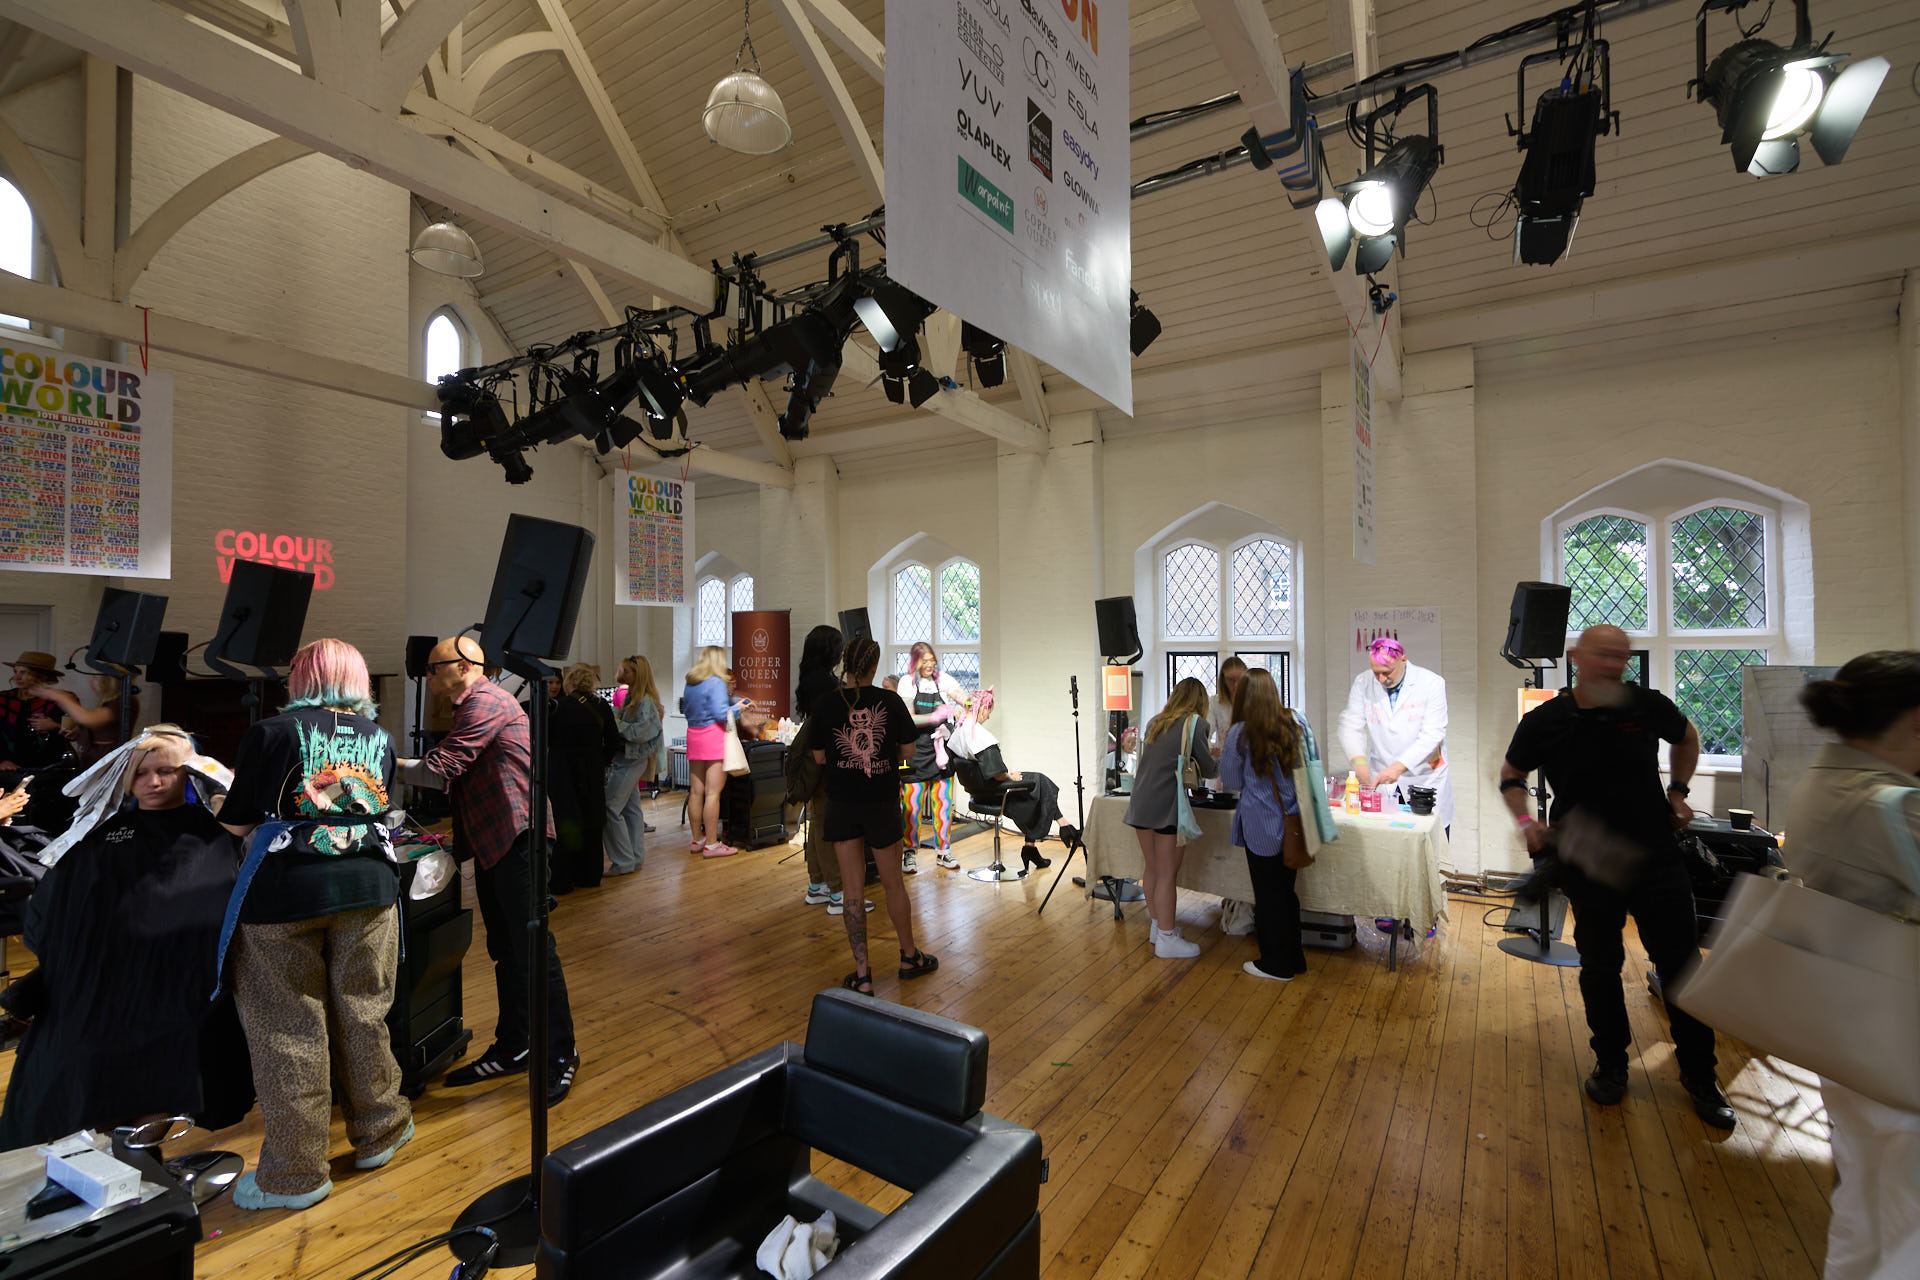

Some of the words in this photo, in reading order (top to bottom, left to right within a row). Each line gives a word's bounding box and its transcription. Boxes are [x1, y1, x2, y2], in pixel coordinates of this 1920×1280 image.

[957, 1, 983, 36] GREEN
[957, 26, 1005, 85] COLLECTIVE
[1065, 49, 1099, 102] AVEDA
[1068, 89, 1099, 140] ESLA
[957, 126, 968, 141] PRO
[957, 108, 1012, 172] OLAPLEX
[1063, 129, 1099, 181] easydry
[964, 164, 1011, 216] Warpaint
[0, 348, 141, 399] COLOUR
[0, 376, 141, 423] WORLD
[0, 426, 16, 435] ACK
[36, 411, 59, 422] 10TH
[61, 415, 109, 428] BIRTHDAY!
[37, 421, 60, 430] MAY
[64, 424, 90, 434] 2025
[98, 430, 140, 442] LONDON
[71, 456, 107, 467] EDWARD
[110, 461, 140, 471] DARLEY
[71, 485, 103, 495] CAROLYN
[105, 488, 140, 498] CHAPMAN
[111, 477, 140, 485] HODGES
[628, 475, 683, 499] COLOUR
[106, 507, 139, 516] COURT
[629, 491, 683, 515] WORLD
[70, 543, 96, 551] CASEY
[99, 545, 139, 554] COLEMAN
[214, 528, 335, 563] COLOUR
[739, 656, 781, 667] COPPER
[741, 669, 779, 680] QUEEN
[107, 829, 135, 837] HAIR
